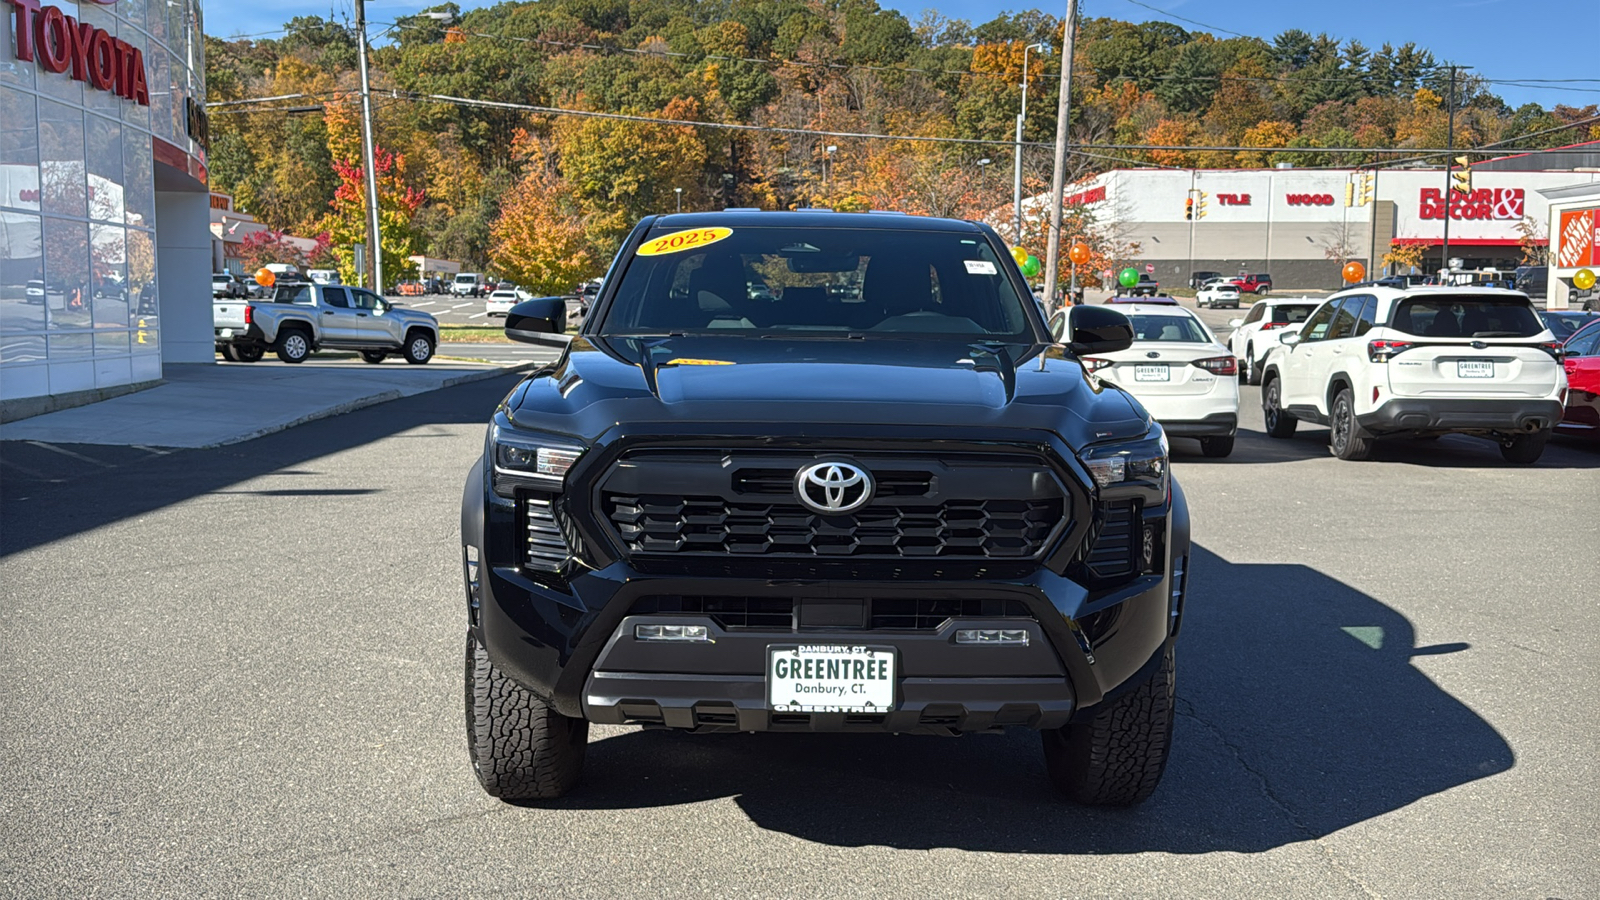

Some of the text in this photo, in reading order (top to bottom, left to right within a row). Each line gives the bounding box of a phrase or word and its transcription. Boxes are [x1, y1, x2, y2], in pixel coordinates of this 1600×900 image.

[2, 0, 150, 106] TOYOTA
[1216, 193, 1251, 206] TILE
[1286, 193, 1335, 206] WOOD
[1420, 188, 1493, 204] FLOOR
[1493, 187, 1524, 220] &
[1419, 203, 1493, 220] DECOR
[1560, 210, 1593, 267] HOME
[1563, 215, 1578, 240] THE
[655, 229, 716, 253] 2025
[1570, 230, 1592, 267] DEPOT
[775, 658, 888, 680] GREENTREE
[795, 682, 867, 697] Danbury, CT.
